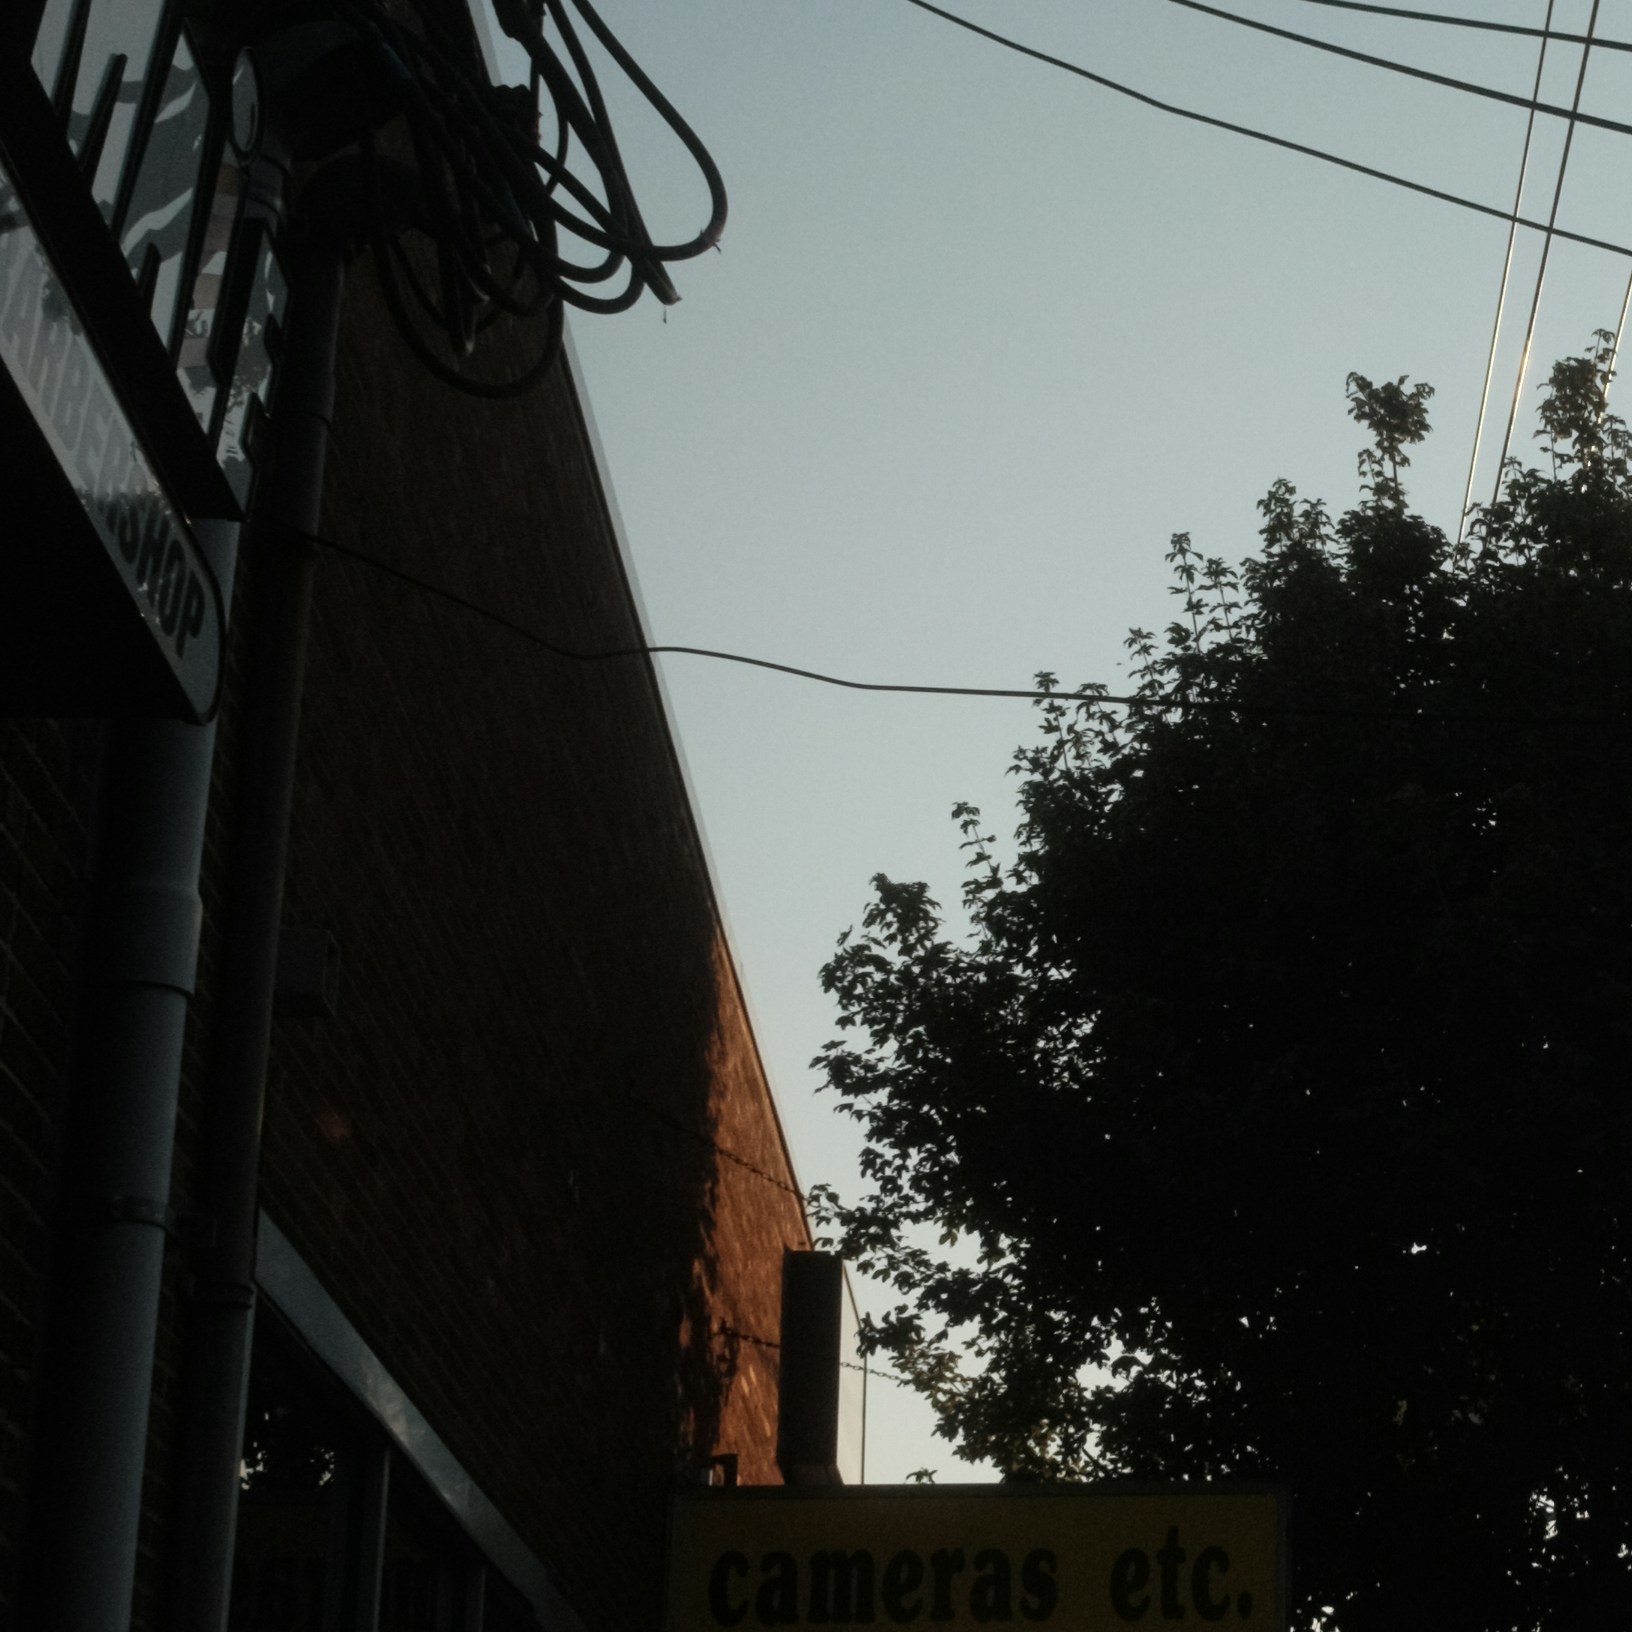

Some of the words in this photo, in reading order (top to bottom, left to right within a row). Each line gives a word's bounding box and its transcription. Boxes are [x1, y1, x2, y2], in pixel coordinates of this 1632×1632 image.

[0, 226, 206, 660] ARBERSHOP
[707, 1547, 1060, 1628] cameras
[1109, 1525, 1255, 1623] etc.
